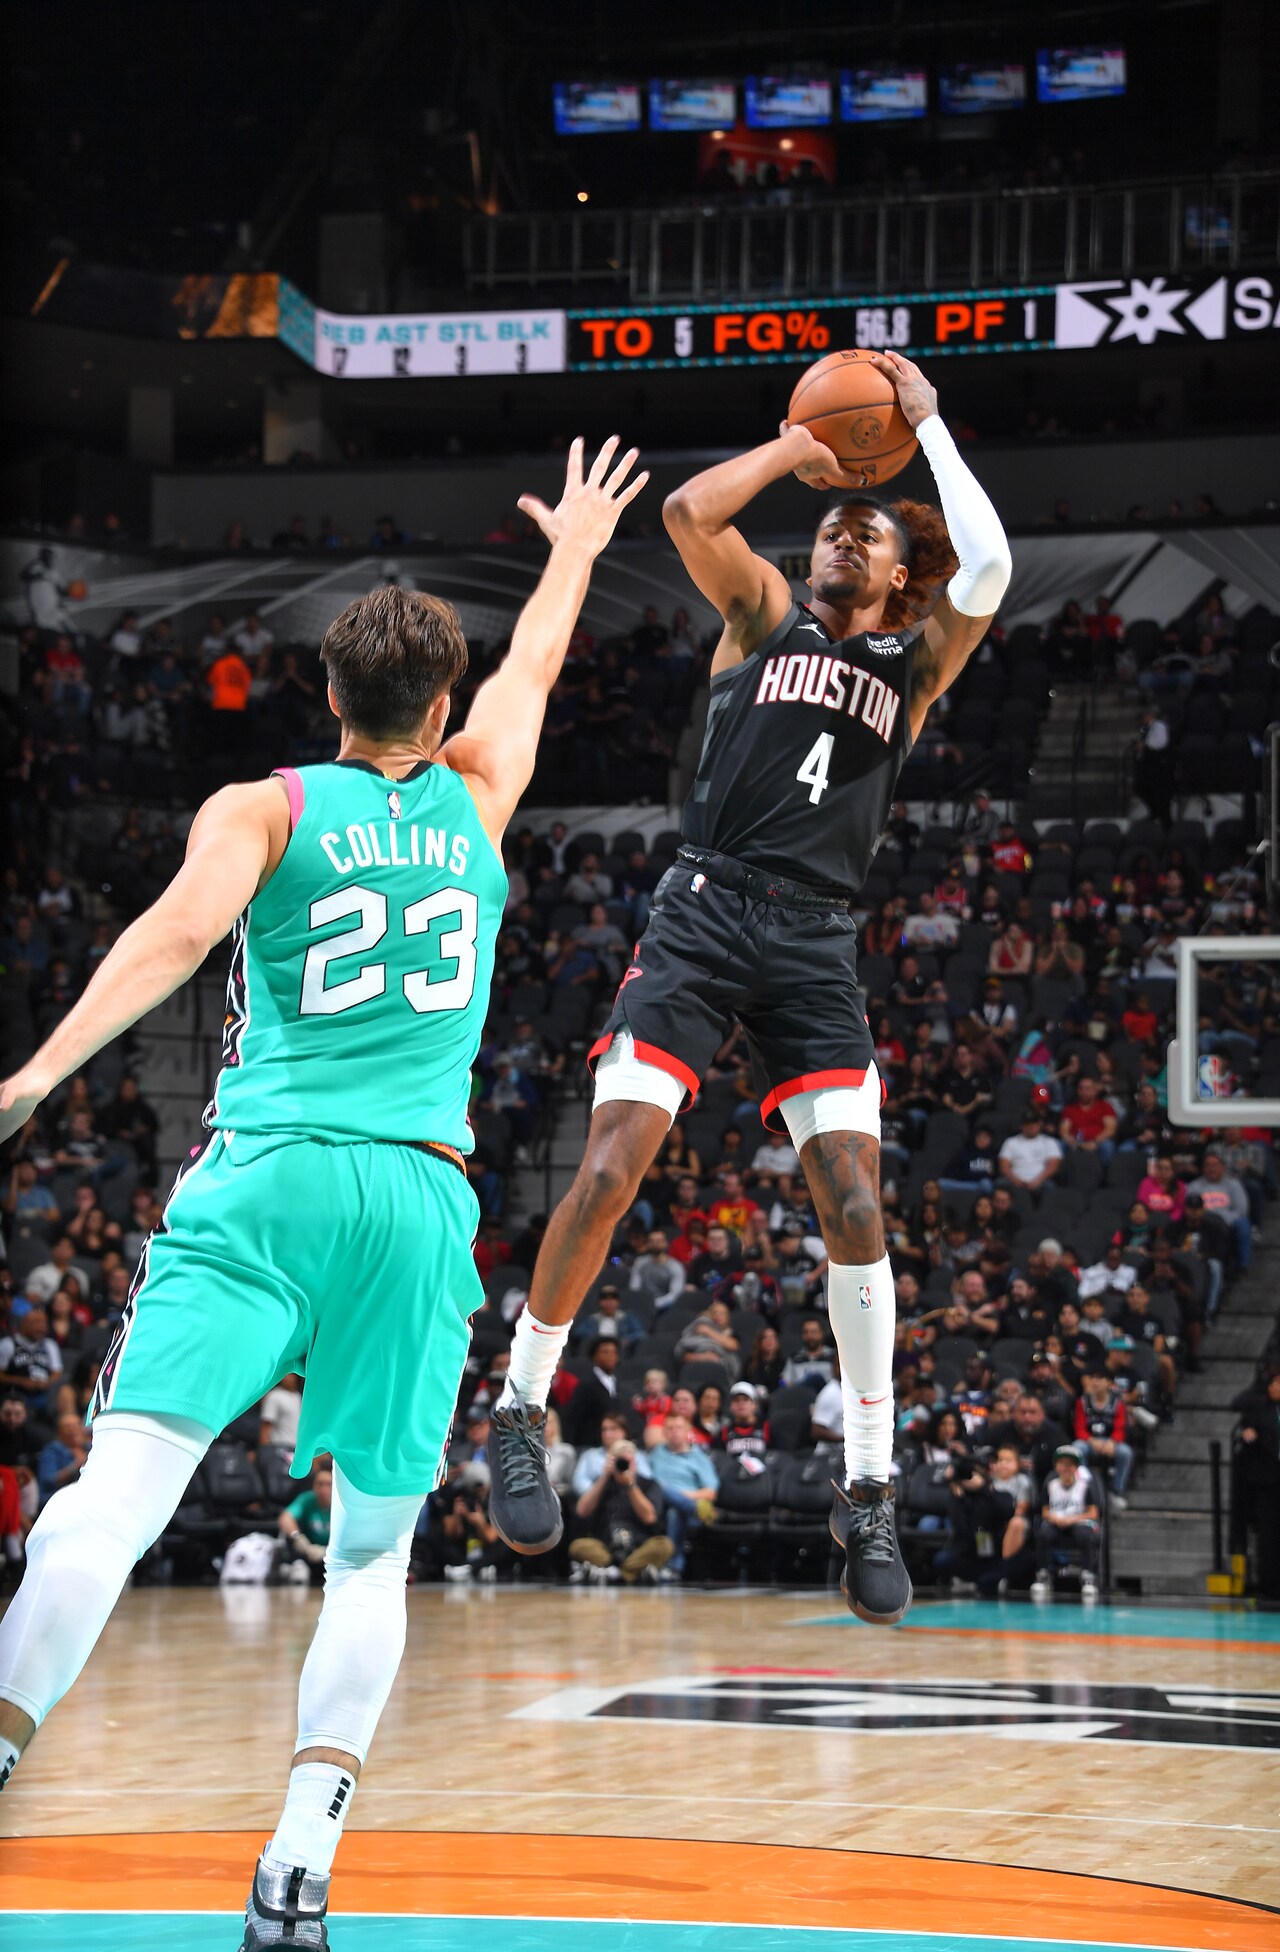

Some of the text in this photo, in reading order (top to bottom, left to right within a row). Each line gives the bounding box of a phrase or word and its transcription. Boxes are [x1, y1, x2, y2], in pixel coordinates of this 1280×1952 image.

[375, 323, 429, 344] AST
[438, 322, 490, 342] STL
[497, 319, 550, 340] BLK
[581, 300, 1037, 358] TO 5 FG% 56.8 PF 1
[1233, 276, 1280, 330] S
[754, 654, 900, 745] HOUSTON
[796, 731, 835, 806] 4
[319, 822, 470, 876] COLLINS
[299, 884, 478, 1015] 23
